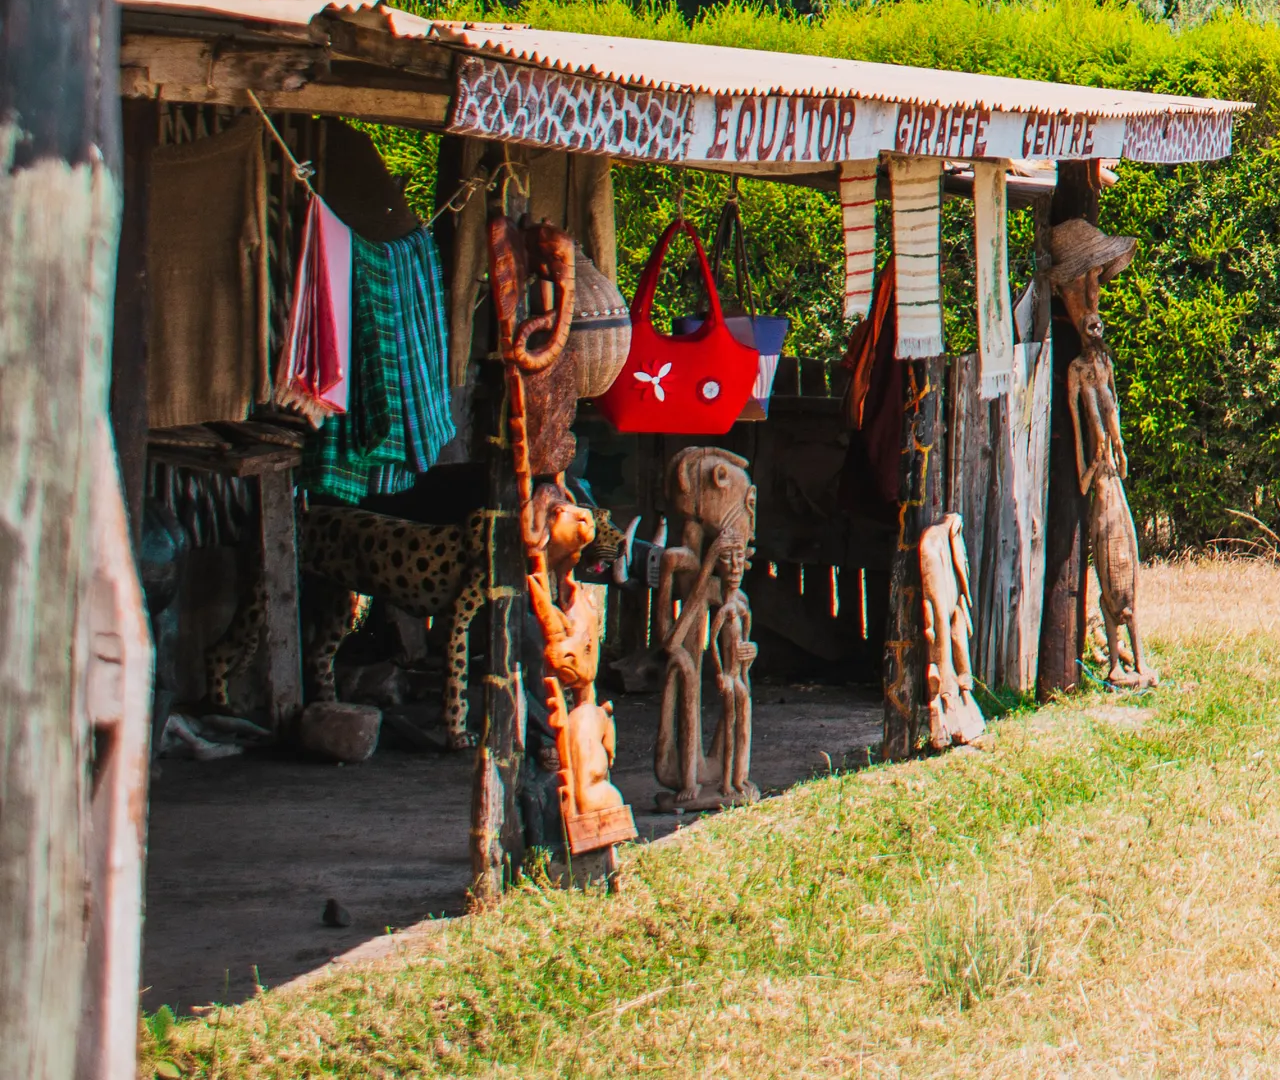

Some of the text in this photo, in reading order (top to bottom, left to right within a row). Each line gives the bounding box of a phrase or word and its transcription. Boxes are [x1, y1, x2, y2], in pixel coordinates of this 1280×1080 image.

[706, 94, 1096, 162] EQUATOR GIRAFFE CENTRE
